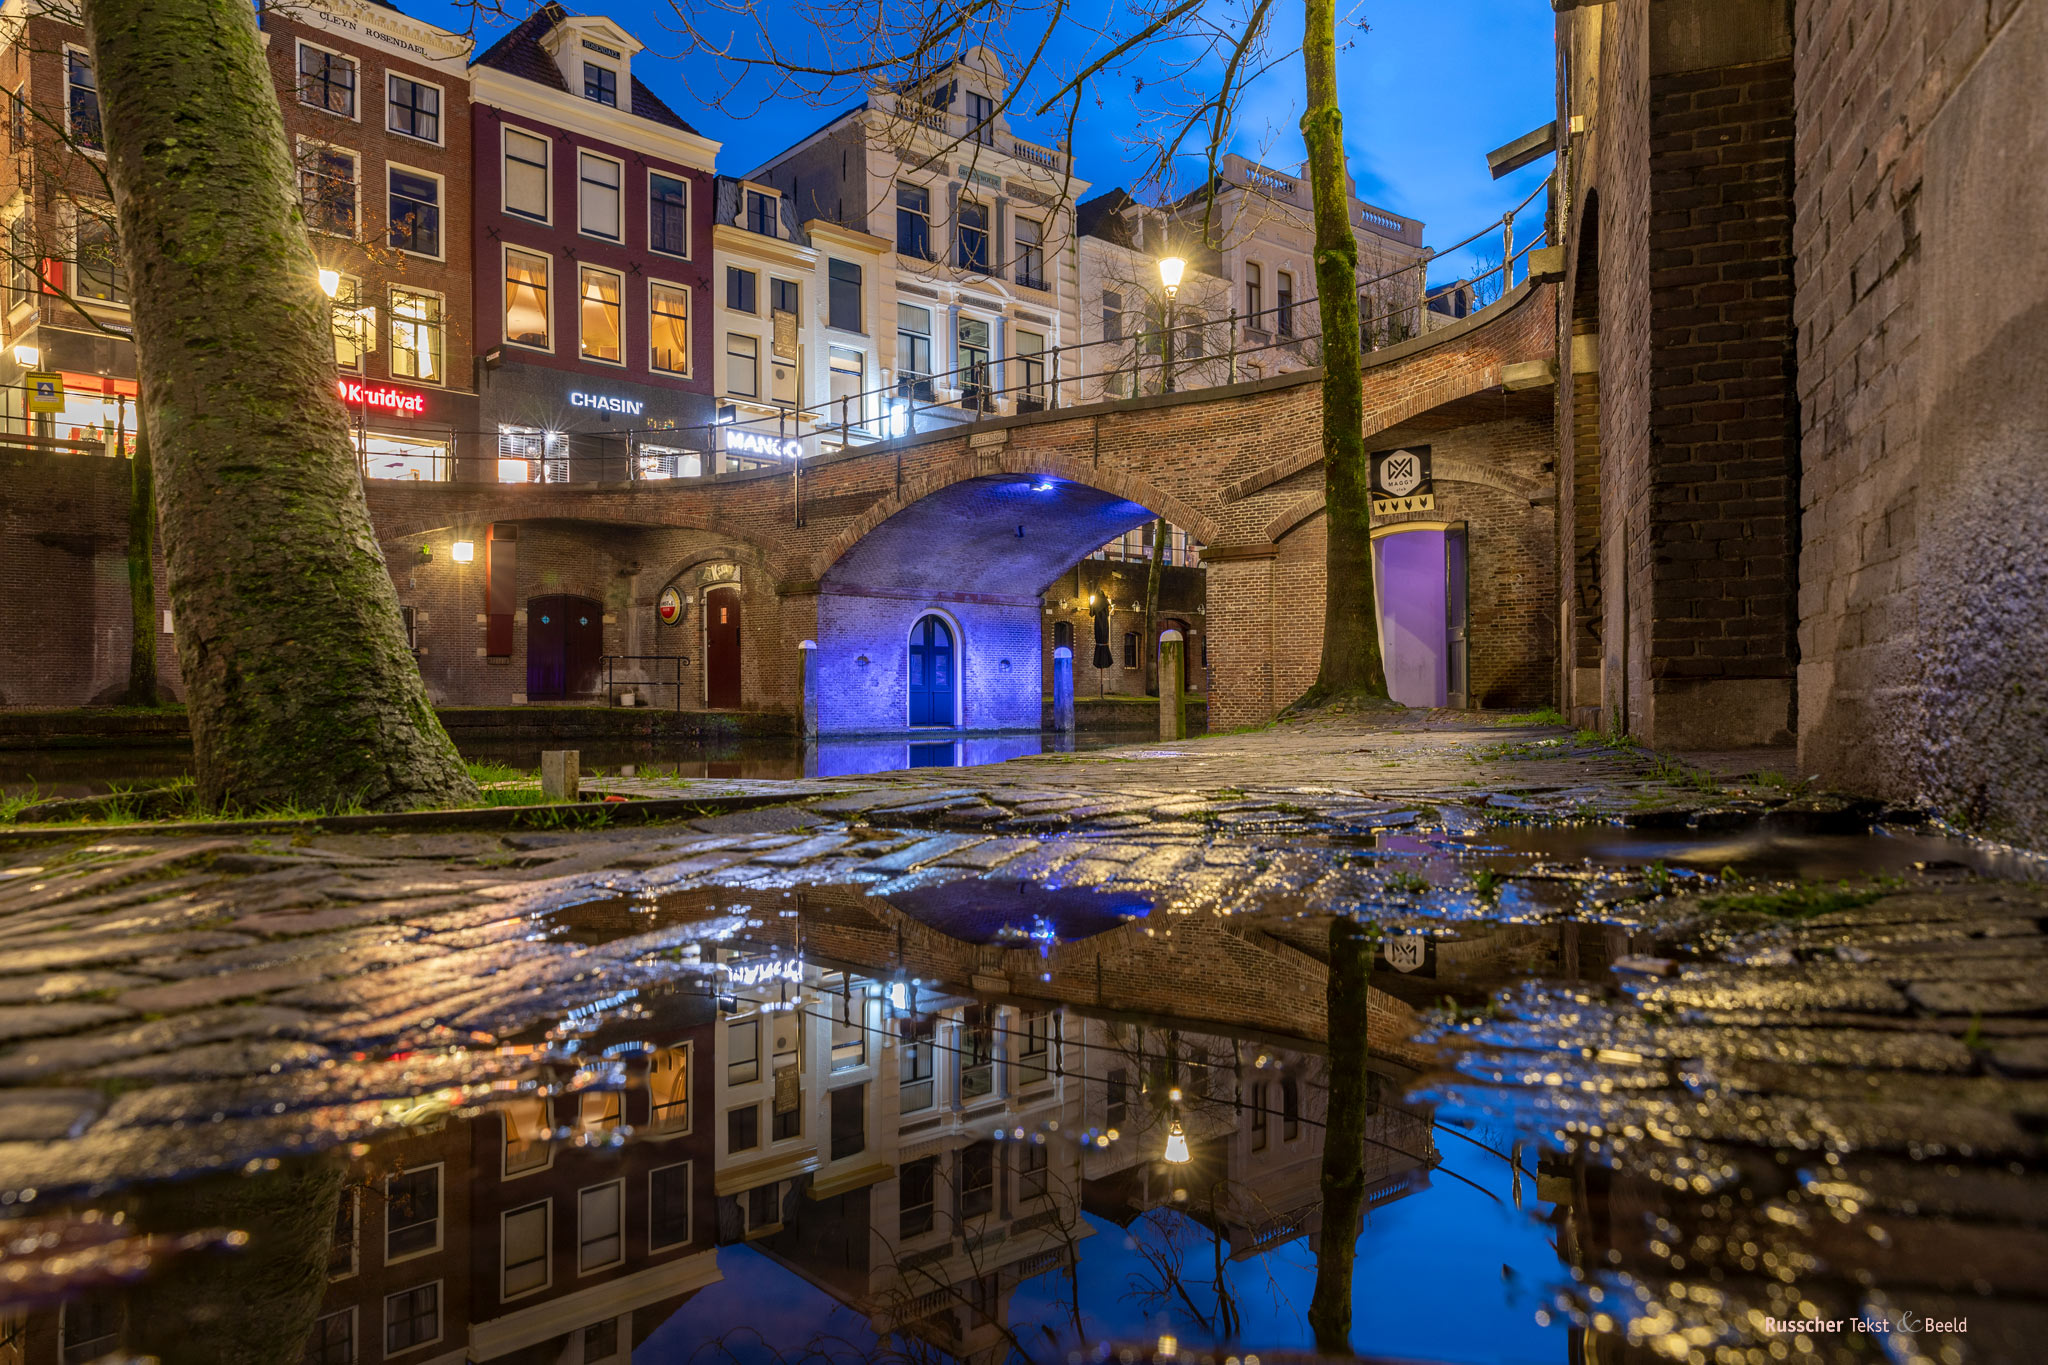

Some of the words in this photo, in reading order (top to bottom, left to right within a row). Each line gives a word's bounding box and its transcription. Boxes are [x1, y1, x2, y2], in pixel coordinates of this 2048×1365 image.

[320, 12, 357, 30] CLEYN
[366, 27, 427, 56] ROSENDAEL
[349, 383, 424, 412] Kruidvat
[570, 392, 643, 415] CHASIN'
[727, 431, 803, 458] MANGO
